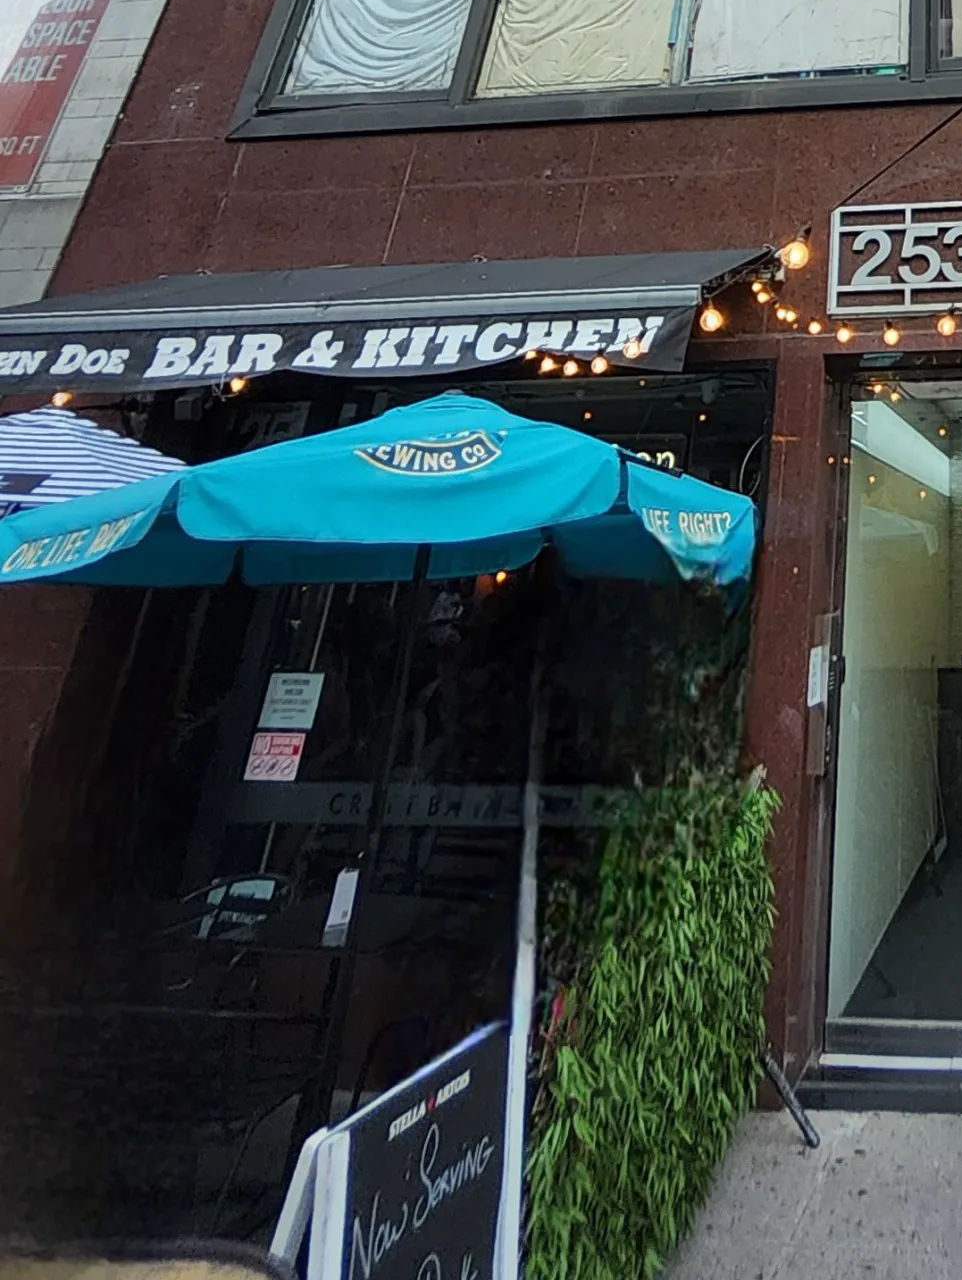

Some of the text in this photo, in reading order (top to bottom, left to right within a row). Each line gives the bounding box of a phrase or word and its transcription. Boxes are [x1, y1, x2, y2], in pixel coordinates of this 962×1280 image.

[22, 19, 97, 48] SPACE
[143, 333, 283, 378] BAR
[291, 330, 345, 368] &
[351, 315, 664, 368] KITCHEN
[368, 444, 456, 471] EWING
[679, 512, 731, 534] RIGHT?
[1, 537, 51, 573] ONE
[388, 1100, 426, 1142] STELLA
